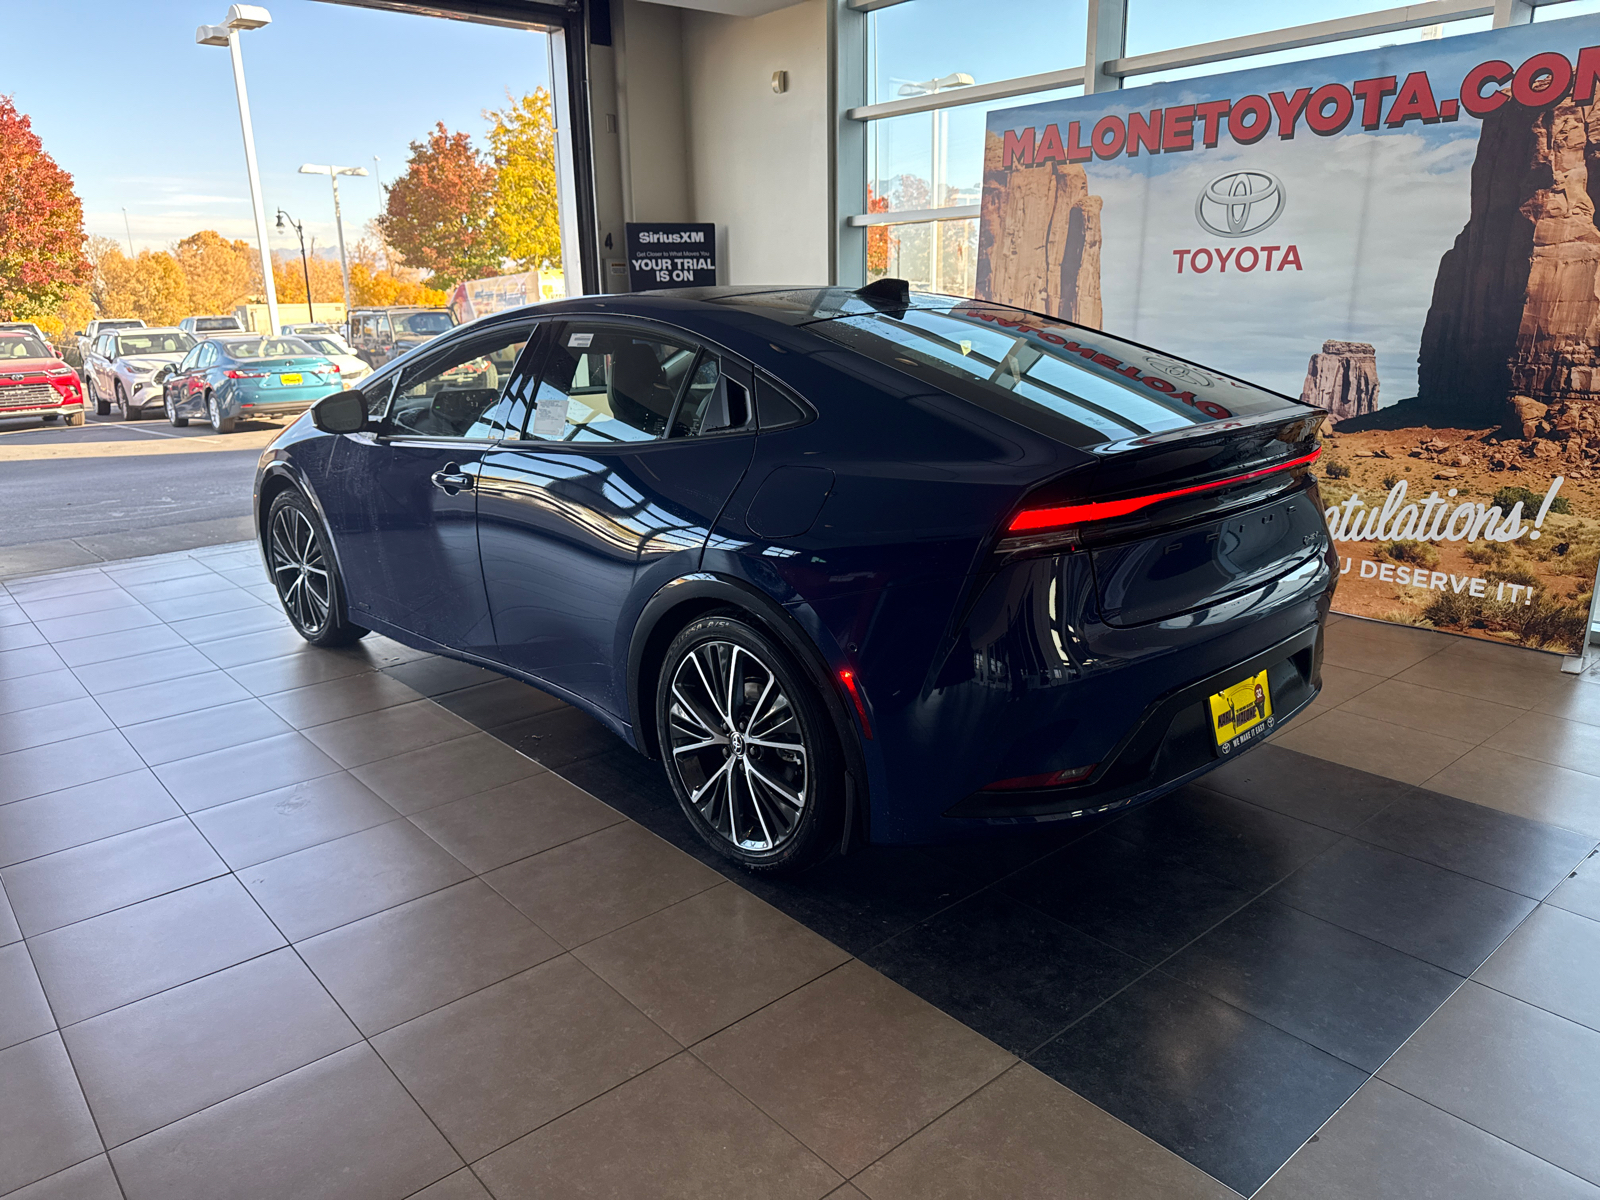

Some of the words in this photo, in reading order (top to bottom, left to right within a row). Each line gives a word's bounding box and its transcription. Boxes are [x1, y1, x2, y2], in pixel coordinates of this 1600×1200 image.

[604, 232, 613, 250] 4
[639, 231, 705, 243] SiriusXM
[631, 258, 672, 271] YOUR
[674, 258, 715, 270] TRIAL
[1172, 245, 1303, 274] TOYOTA
[656, 270, 670, 282] IS
[672, 270, 694, 281] ON
[1360, 560, 1487, 599] DESERVE
[1496, 582, 1534, 606] IT!
[1232, 737, 1240, 748] WE
[1240, 731, 1251, 744] MAKE
[1251, 728, 1256, 737] IT
[1255, 722, 1265, 735] EASY
